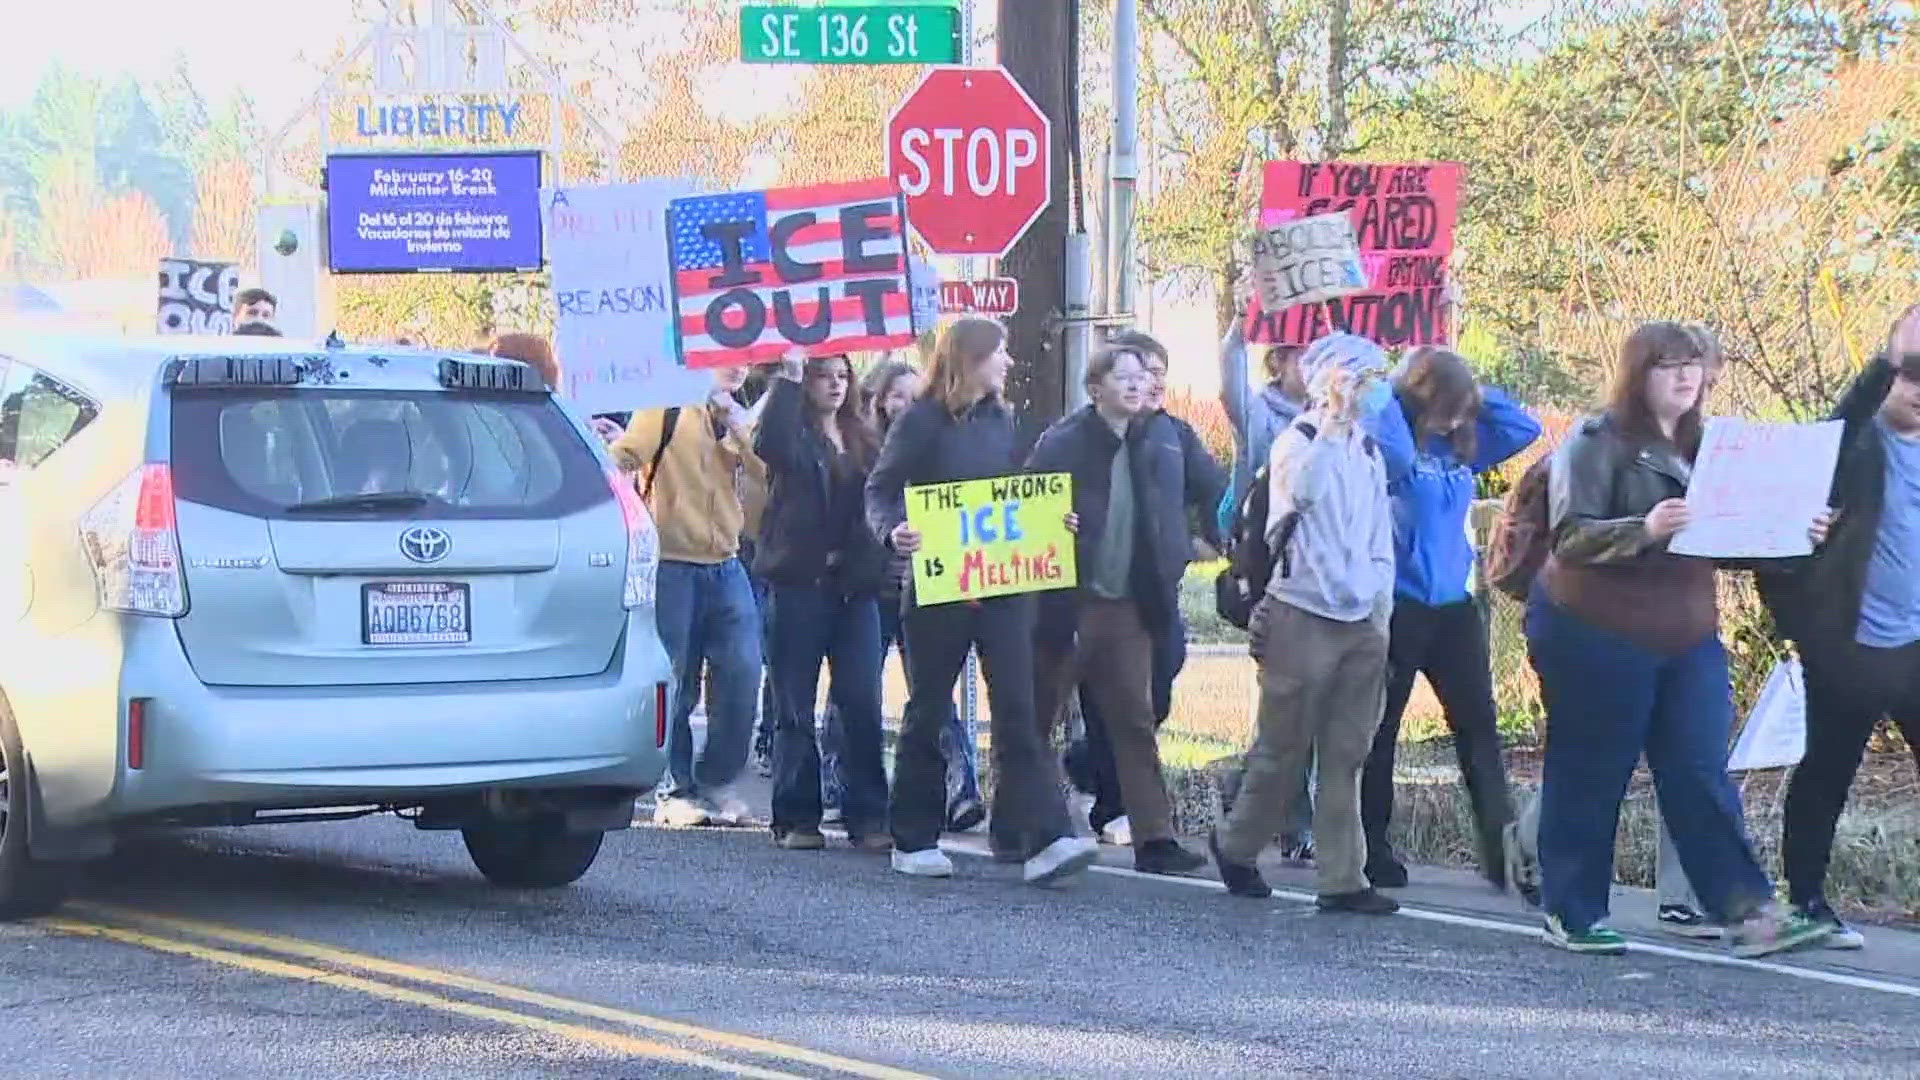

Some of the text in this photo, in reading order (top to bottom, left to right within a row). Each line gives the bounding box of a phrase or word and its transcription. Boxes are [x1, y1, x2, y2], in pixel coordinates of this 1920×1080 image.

[761, 13, 919, 57] SE 136 St
[357, 102, 520, 137] LIBERTY
[374, 168, 492, 184] February 16-20
[899, 127, 1038, 197] STOP
[370, 183, 496, 197] Midwinter Break
[1298, 163, 1431, 197] IF YOU ARE
[359, 213, 380, 225] Del
[415, 212, 434, 225] 20
[436, 212, 452, 225] de
[433, 226, 450, 239] de
[452, 225, 491, 238] mitad
[493, 225, 511, 239] de
[1303, 196, 1437, 250] ARED
[701, 201, 899, 290] ICE
[1279, 256, 1337, 299] ICE
[557, 282, 667, 317] REASON
[705, 279, 899, 348] OUT
[938, 285, 963, 308] LL
[972, 285, 1009, 308] WAY
[915, 475, 1063, 512] THE WRONG
[959, 501, 1024, 547] ICE
[925, 556, 945, 578] IS
[371, 604, 463, 633] AQB6768
